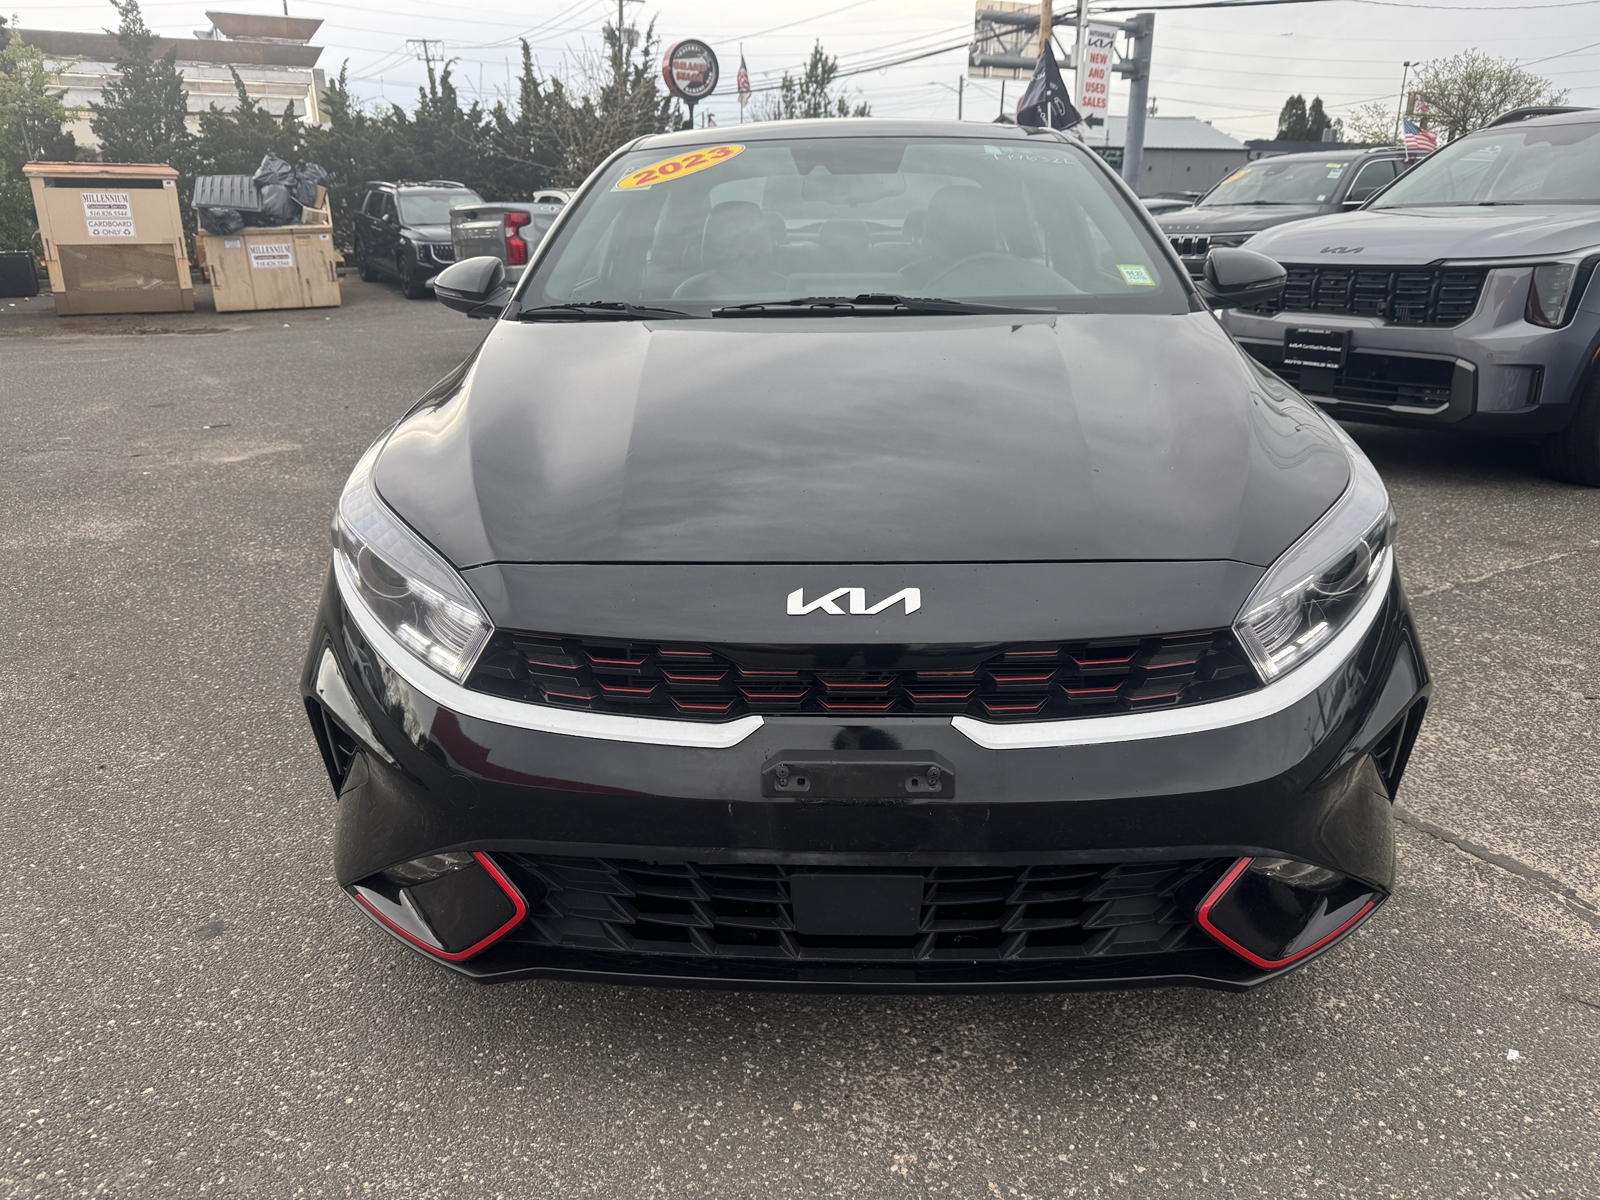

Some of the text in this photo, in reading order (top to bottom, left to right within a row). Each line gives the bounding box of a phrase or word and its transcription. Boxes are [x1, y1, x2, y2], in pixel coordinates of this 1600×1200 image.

[1088, 38, 1114, 49] KIA
[1090, 53, 1108, 65] NEW
[1088, 68, 1105, 79] AND
[1085, 82, 1106, 94] USED
[1082, 96, 1107, 109] SALES
[633, 147, 734, 186] 2023
[82, 194, 129, 203] MILLENNIUM
[1320, 246, 1365, 254] KIA
[787, 587, 921, 616] KIA
